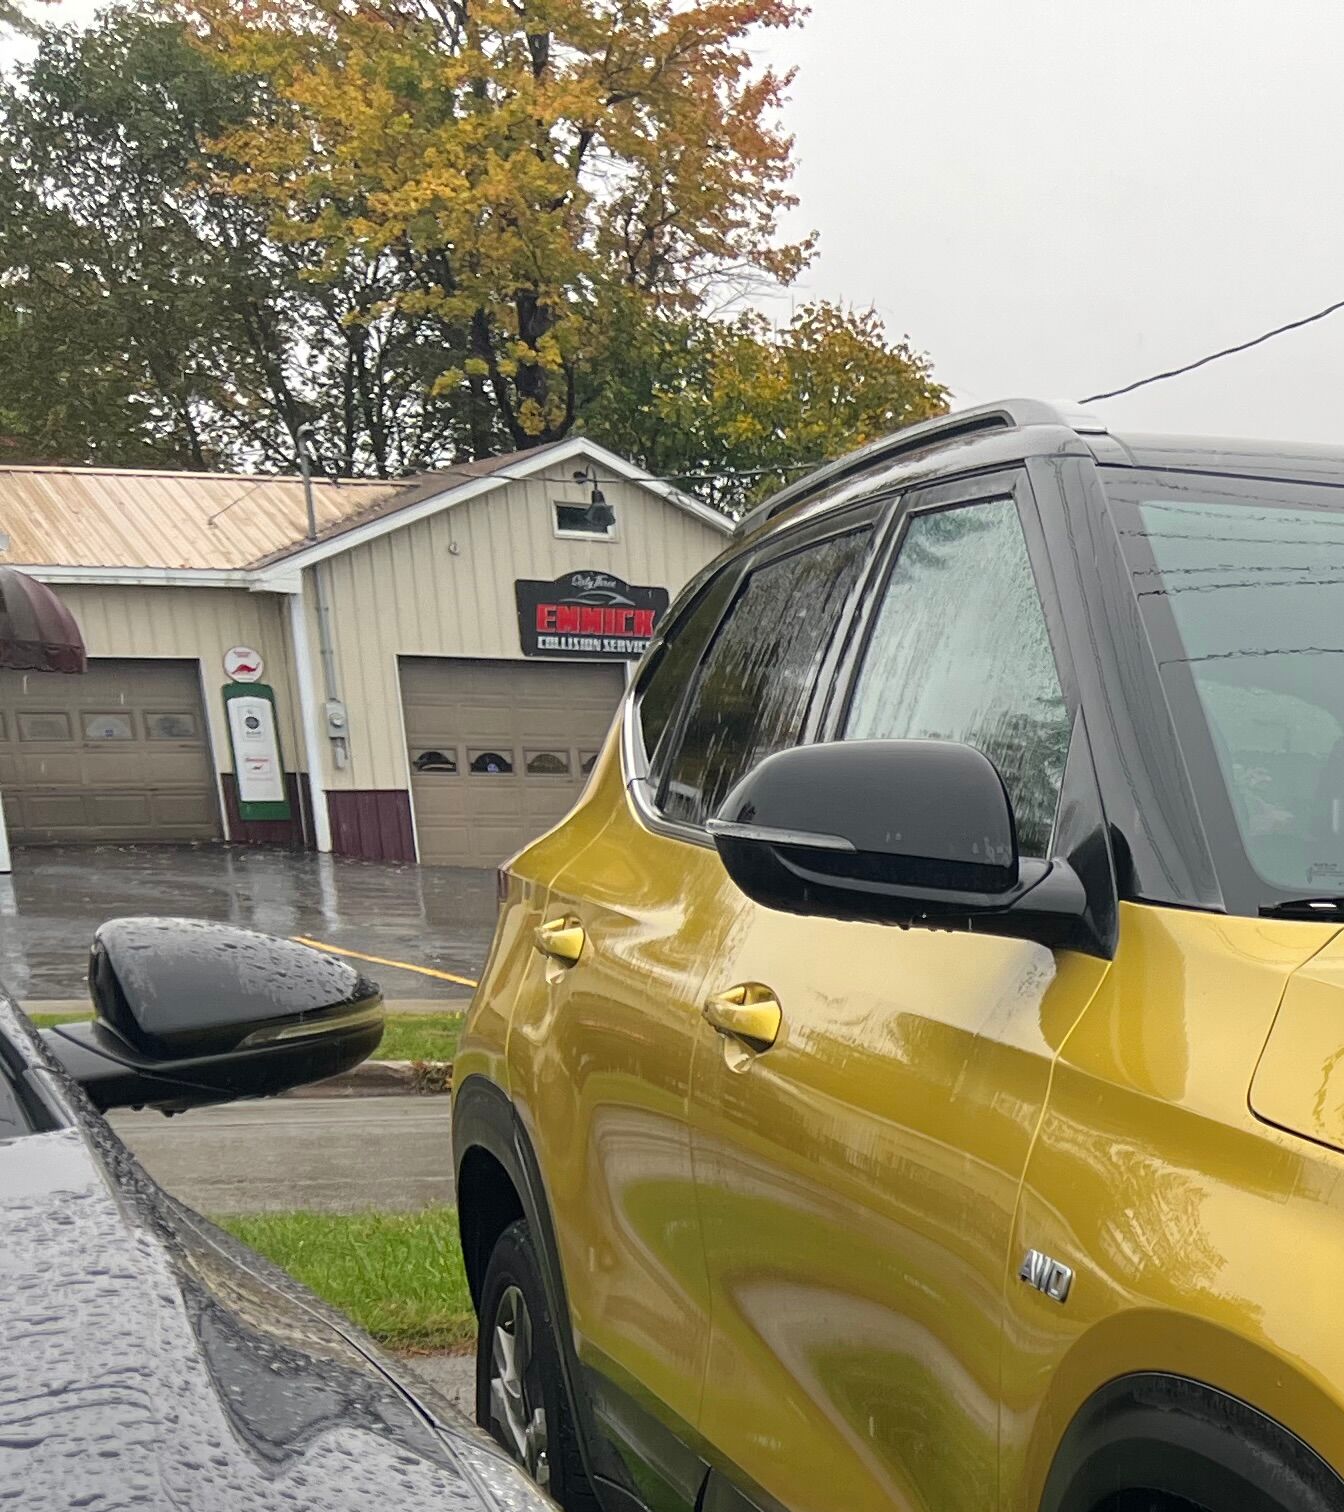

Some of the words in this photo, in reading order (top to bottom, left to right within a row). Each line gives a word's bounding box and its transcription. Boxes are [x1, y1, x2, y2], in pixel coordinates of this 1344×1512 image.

[536, 604, 655, 637] EMMICK
[537, 636, 601, 651] COLLISION
[603, 639, 651, 654] SERVIC
